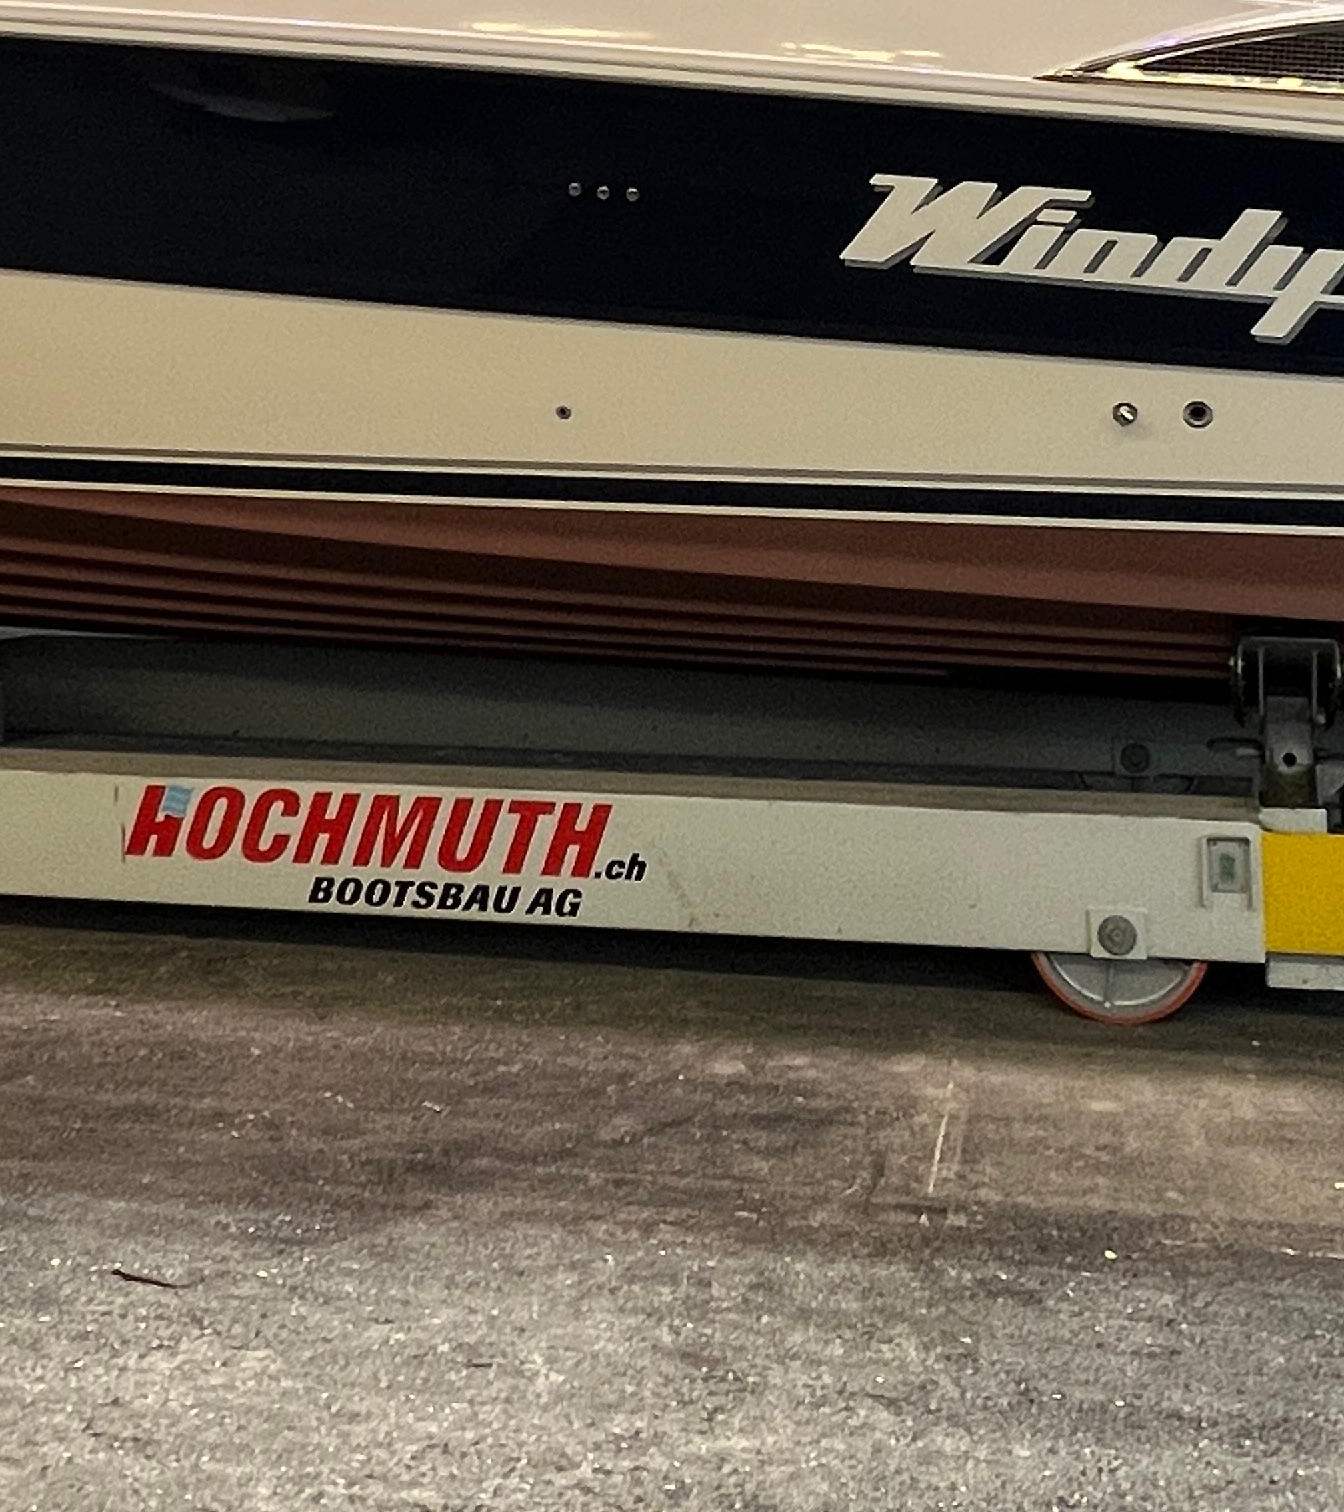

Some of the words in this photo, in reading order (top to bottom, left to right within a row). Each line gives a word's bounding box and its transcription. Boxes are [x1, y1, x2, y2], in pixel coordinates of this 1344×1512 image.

[124, 783, 648, 884] HOCHMUTH.ch
[307, 876, 522, 915] BOOTSBAU
[525, 887, 585, 919] AG
